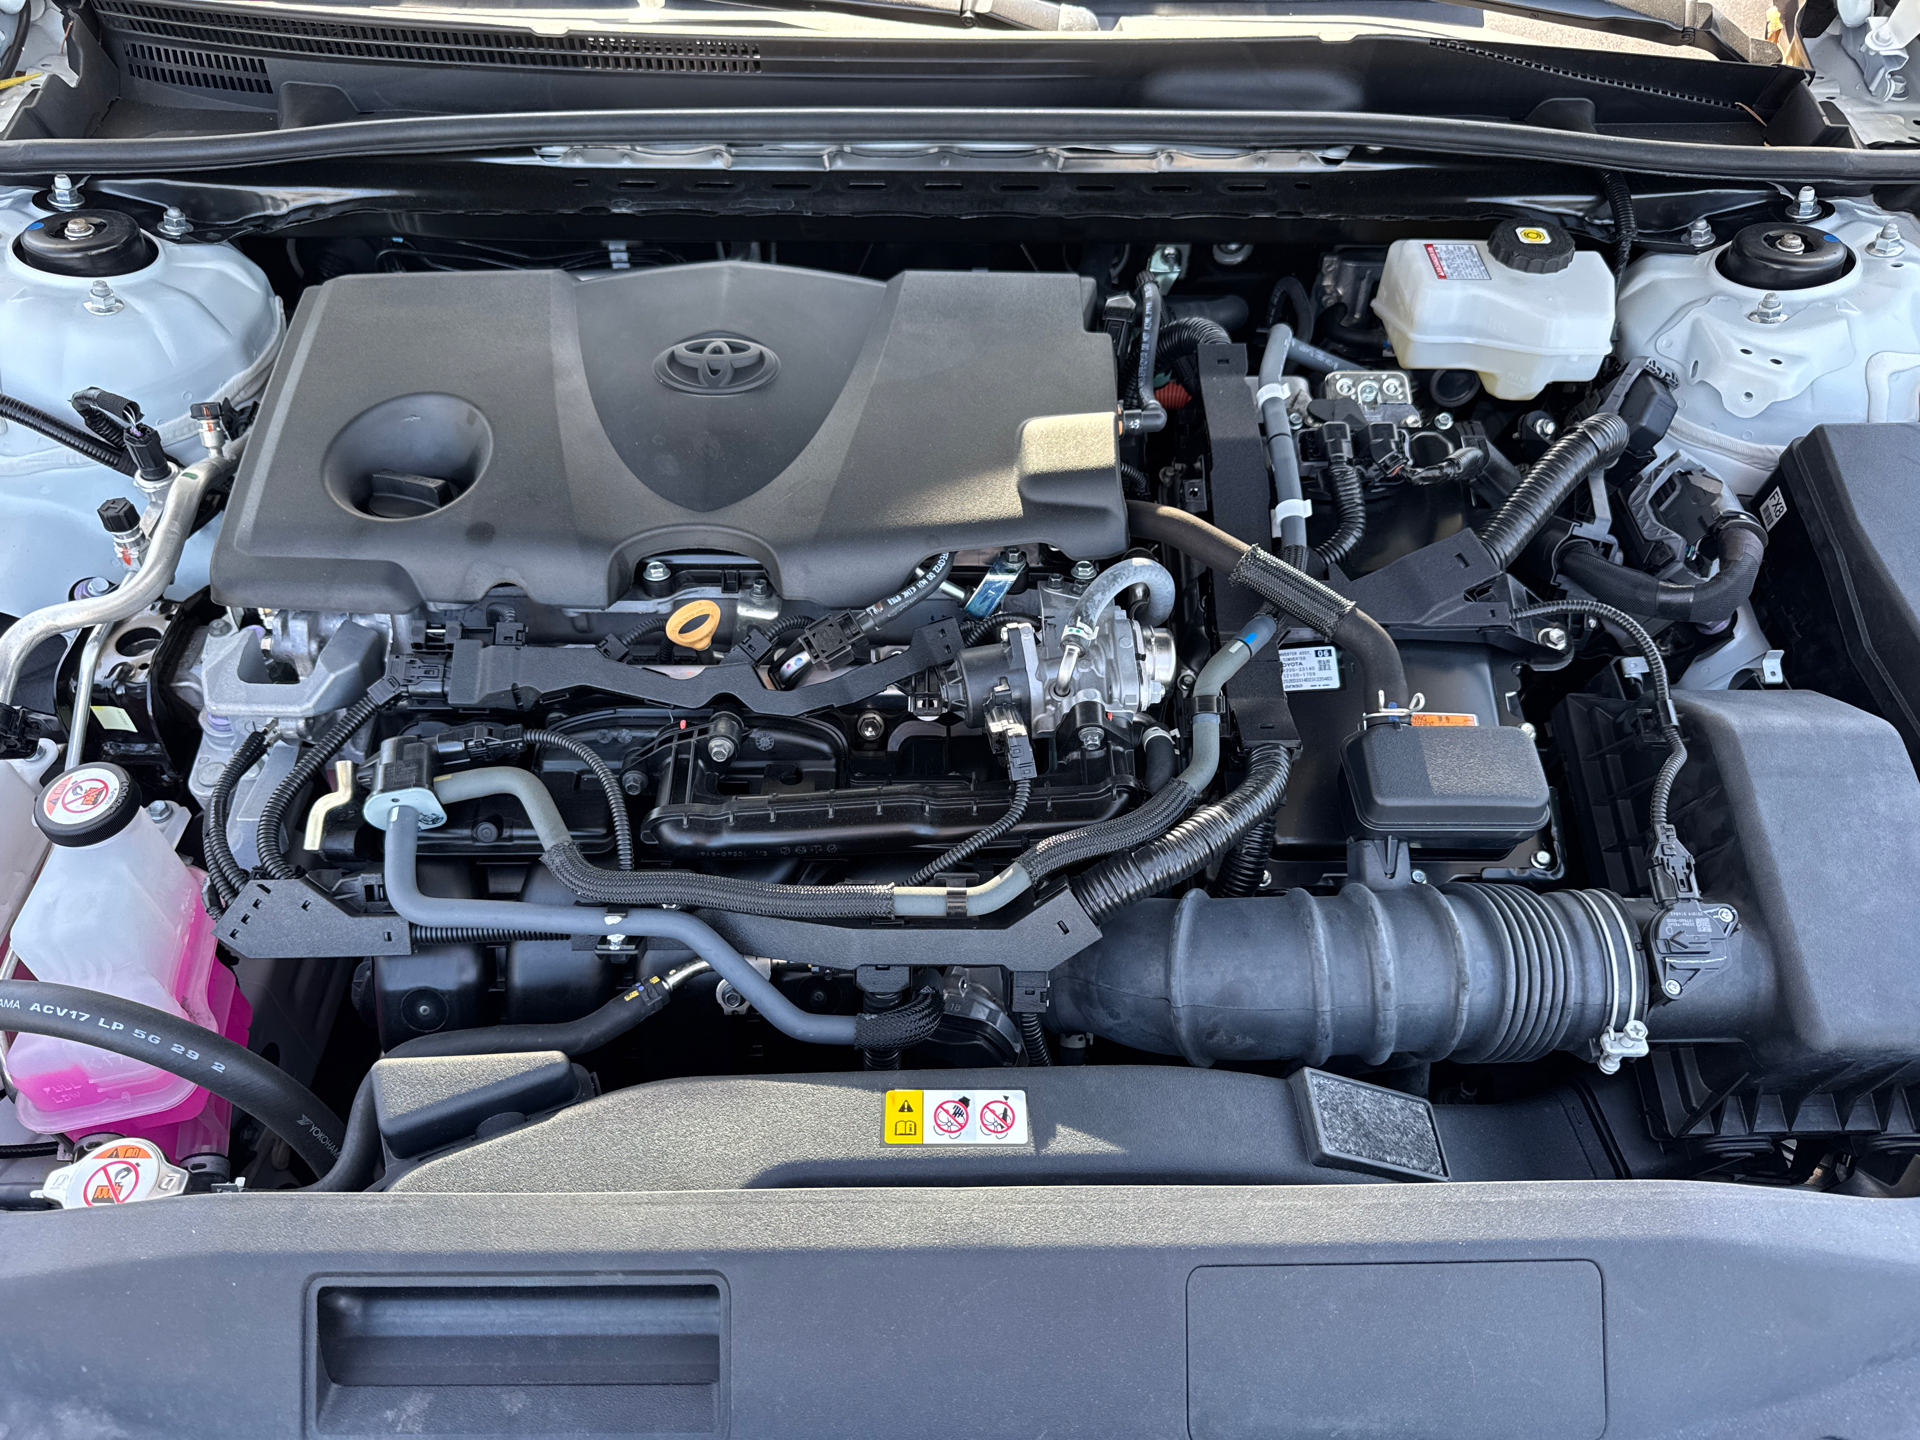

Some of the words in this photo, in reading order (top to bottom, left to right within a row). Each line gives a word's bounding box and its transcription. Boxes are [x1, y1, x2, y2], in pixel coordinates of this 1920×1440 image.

[1769, 490, 1785, 518] FX8
[29, 1002, 91, 1022] ACV17
[98, 1017, 125, 1032] LP
[171, 1043, 200, 1061] 29
[211, 1061, 227, 1074] 2
[51, 1091, 81, 1104] LOW
[309, 1124, 342, 1159] YOKOHAM
